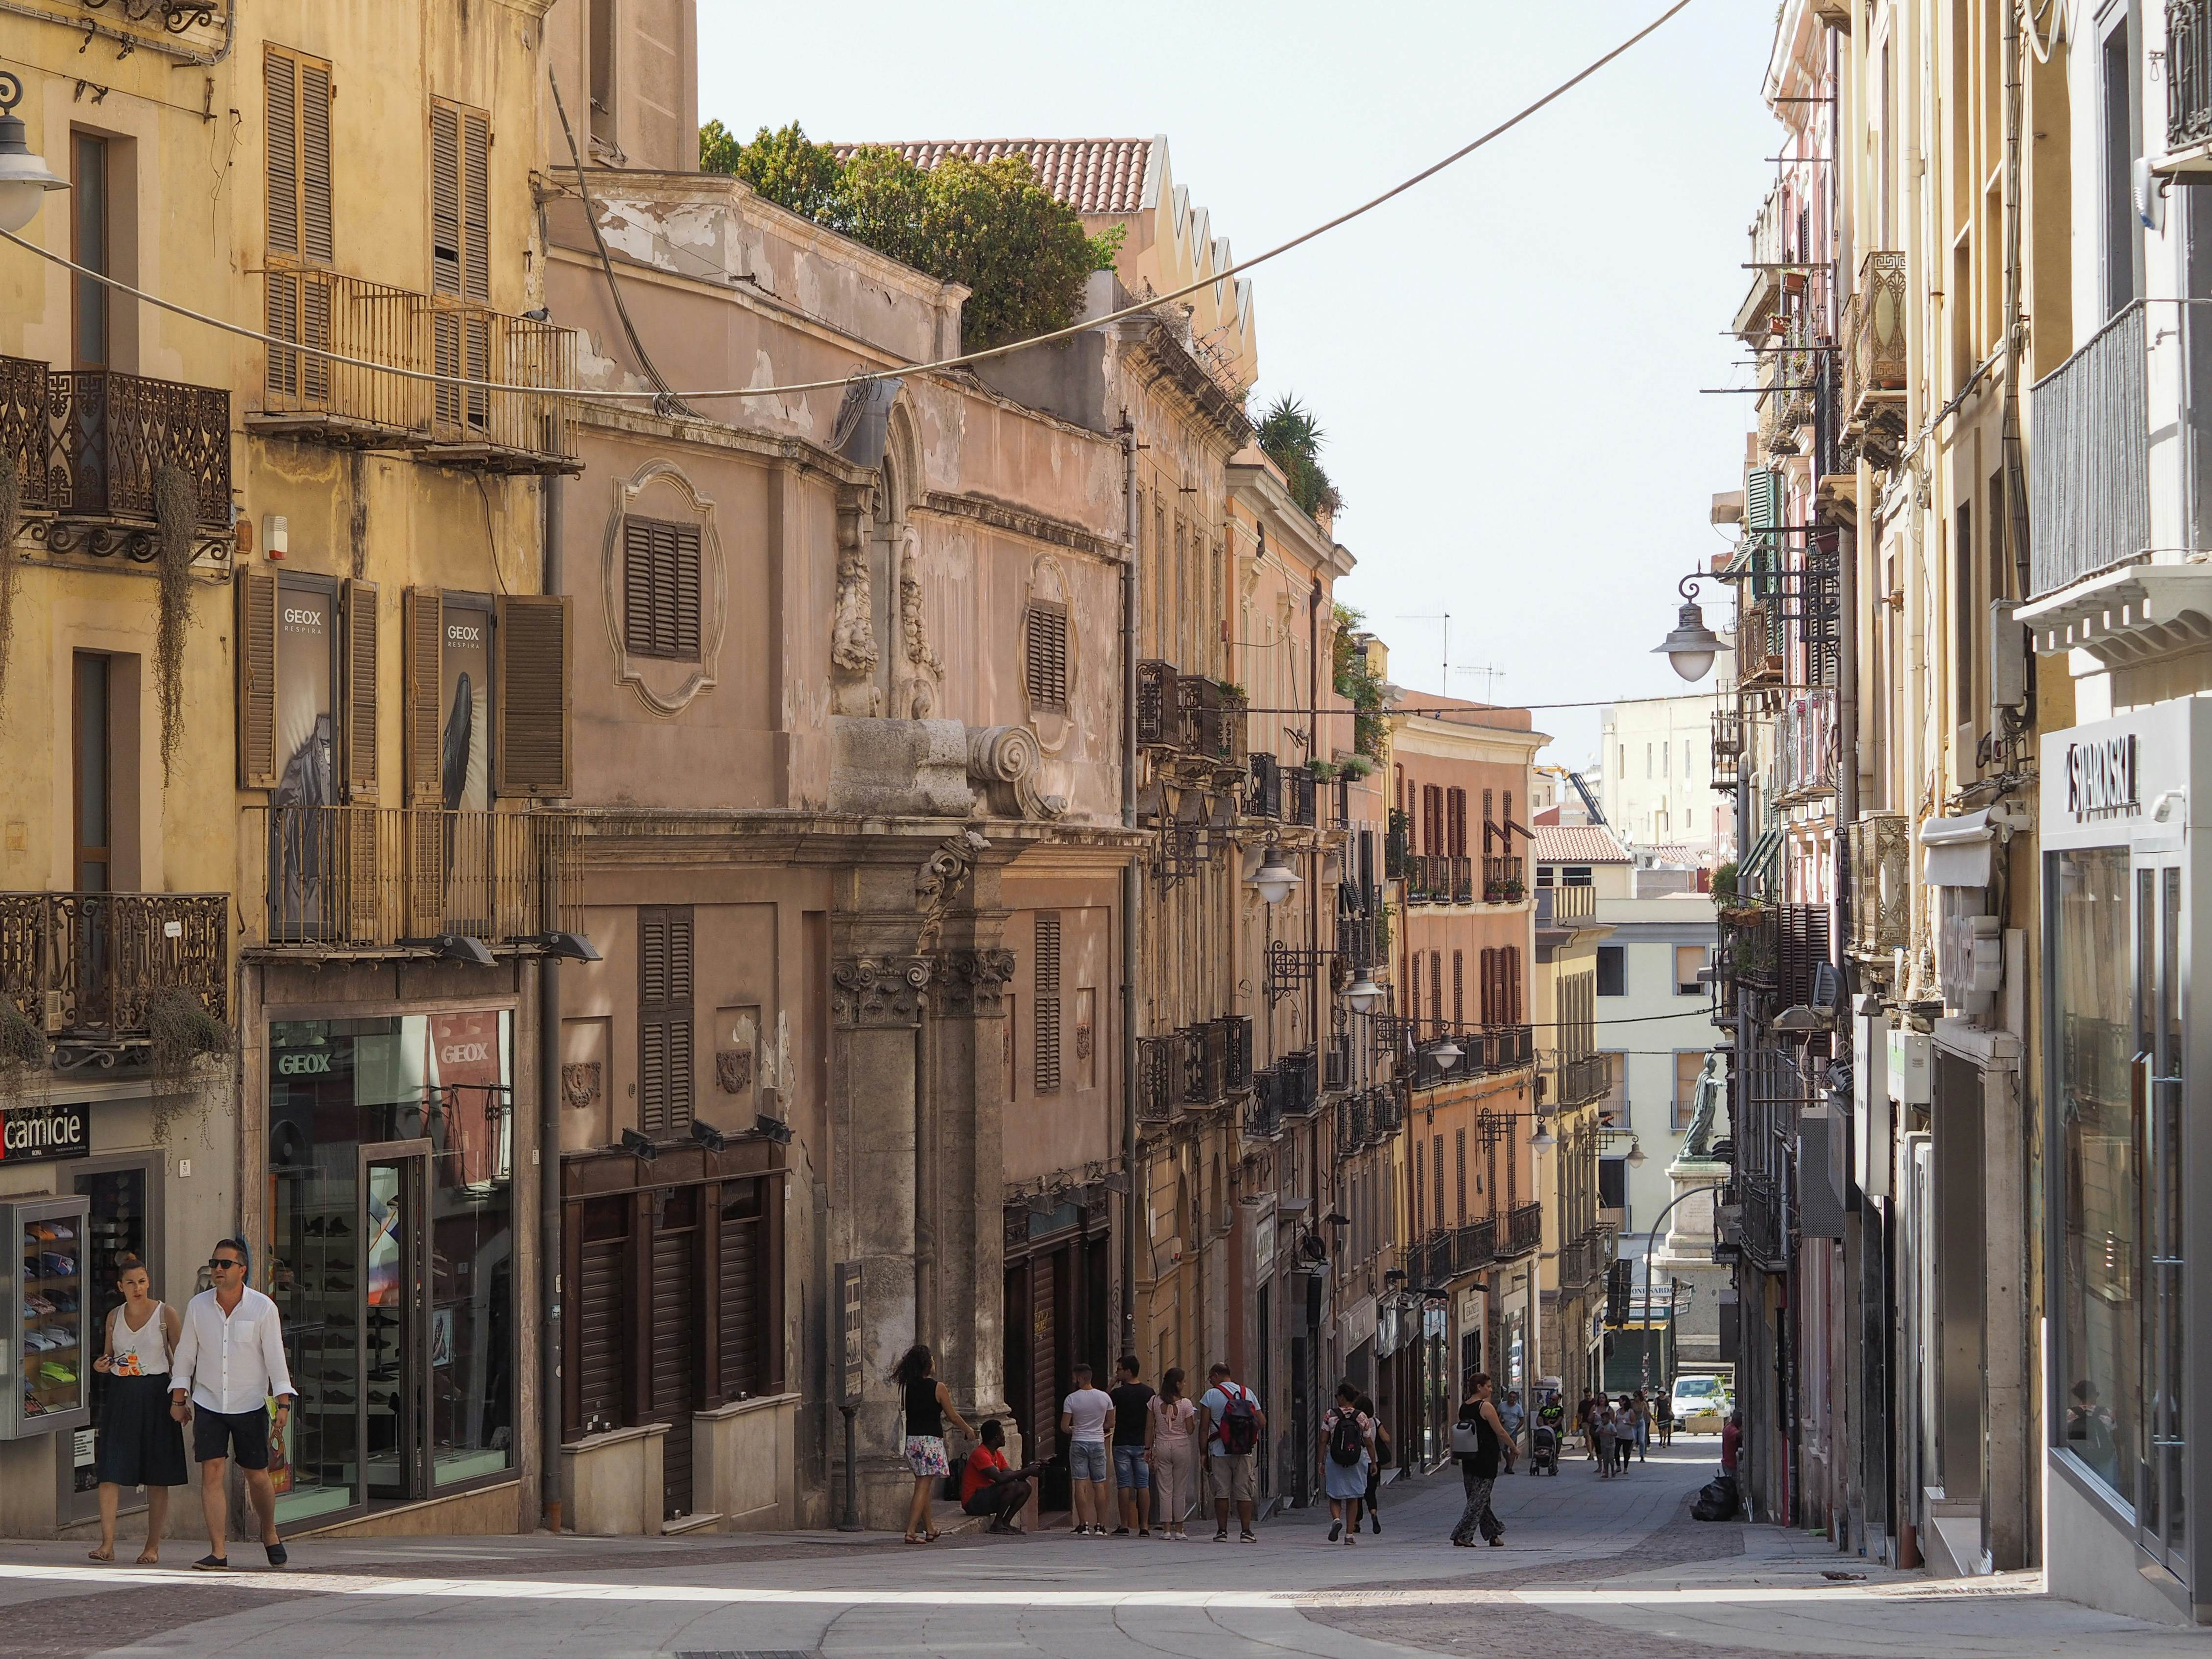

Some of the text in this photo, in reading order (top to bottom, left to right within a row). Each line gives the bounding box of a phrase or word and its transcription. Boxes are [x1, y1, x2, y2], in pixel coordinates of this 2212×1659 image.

[284, 608, 322, 626] GEOX
[285, 625, 321, 635] RESPIRA
[448, 625, 480, 641] GEOX
[2072, 735, 2129, 812] SWAROVSKI
[441, 1042, 489, 1064] GEOX
[279, 1054, 331, 1075] GEOX
[4, 1107, 80, 1150] camicie
